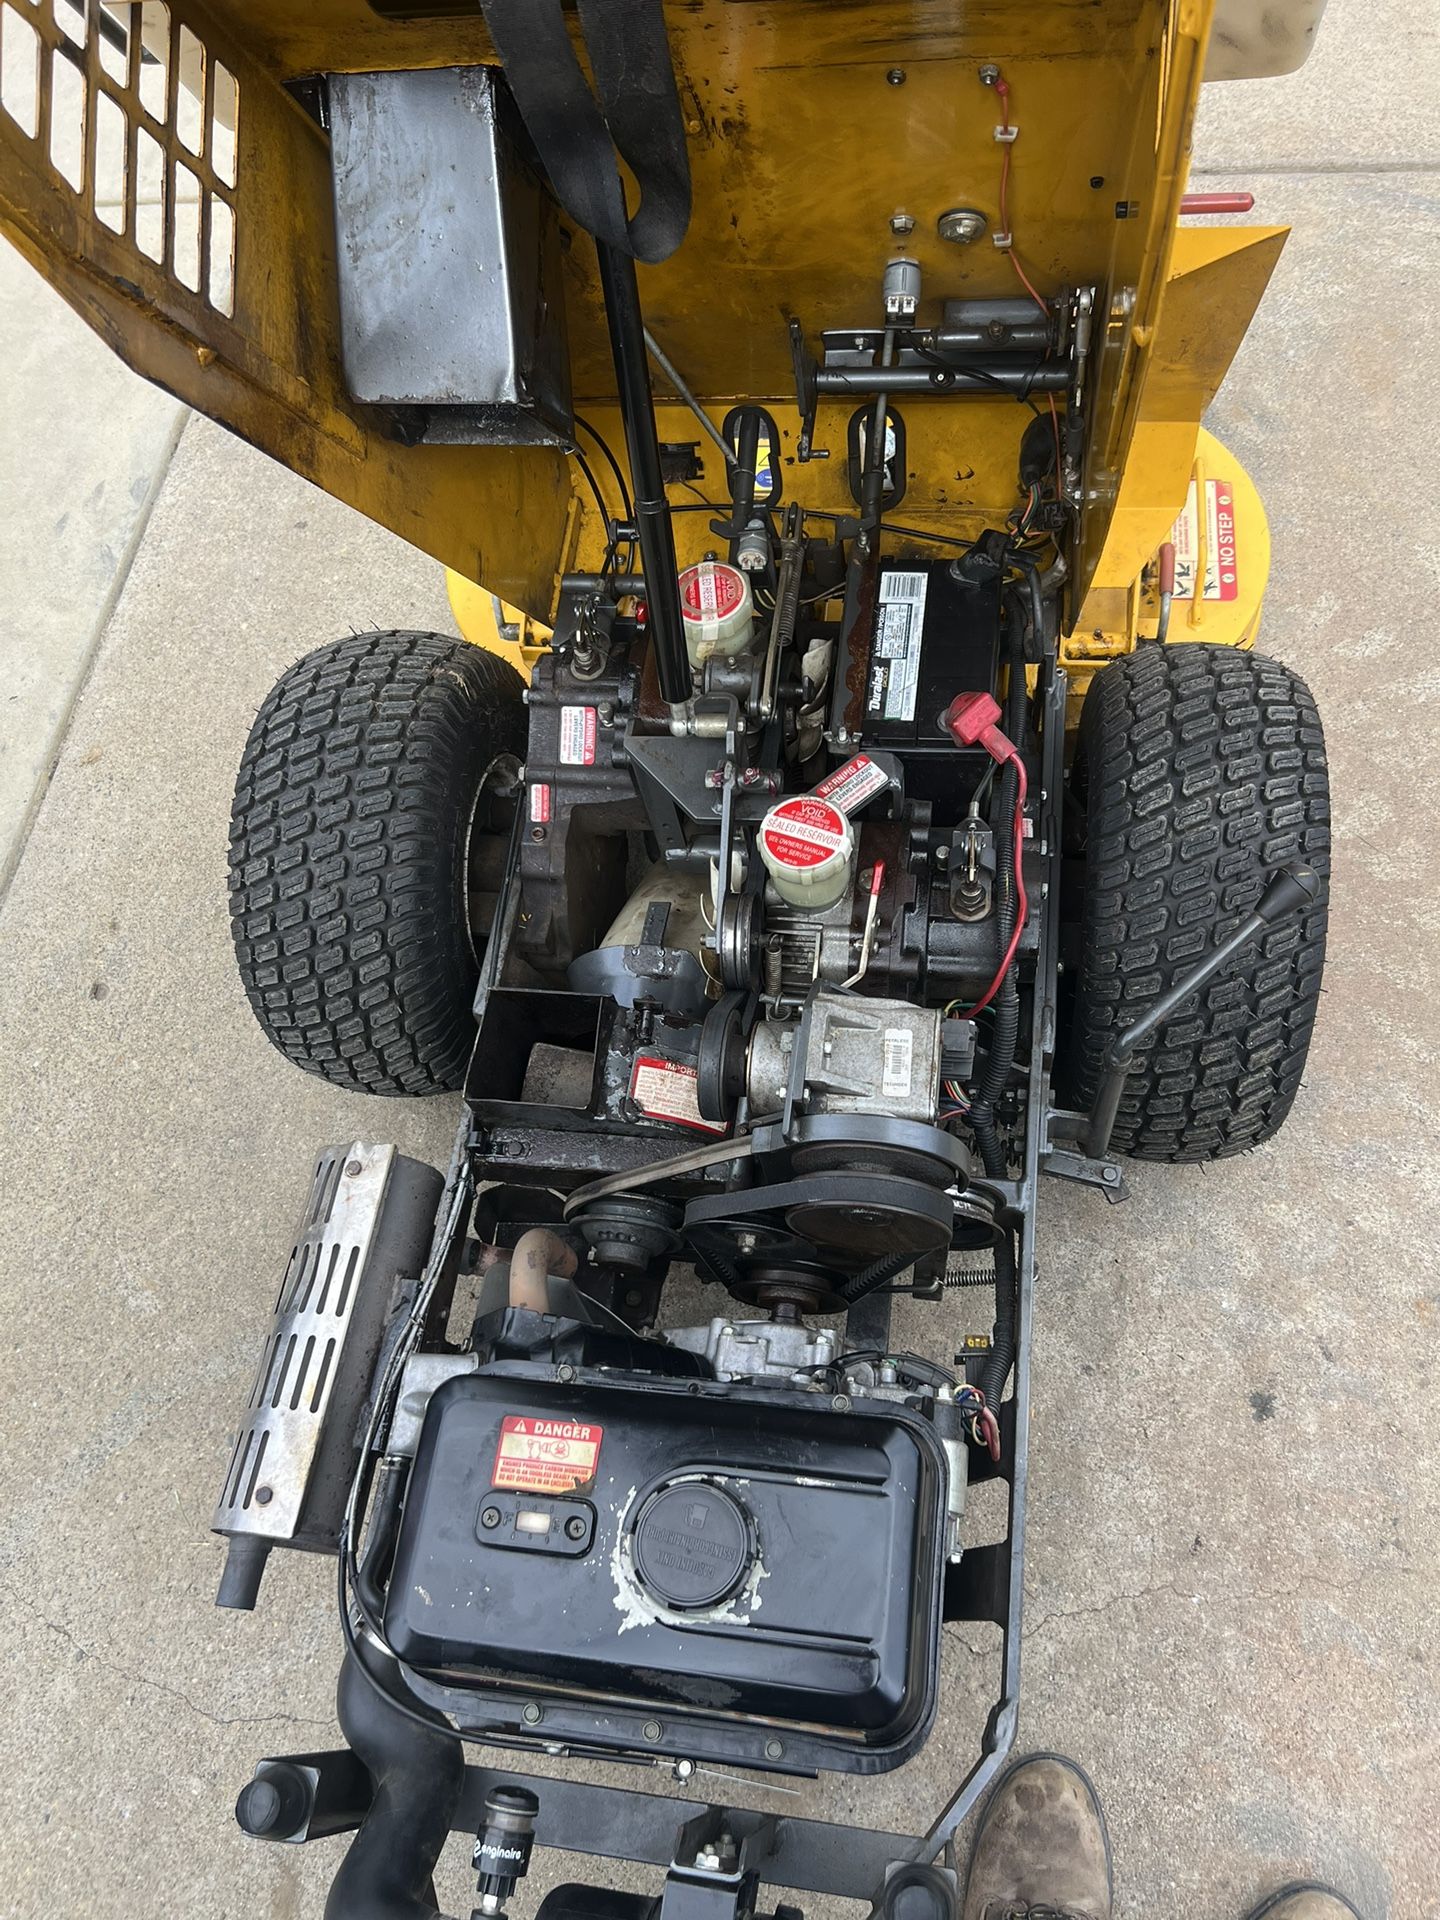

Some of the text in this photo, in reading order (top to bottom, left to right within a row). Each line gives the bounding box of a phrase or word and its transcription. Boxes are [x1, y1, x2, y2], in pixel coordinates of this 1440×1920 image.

[1218, 512, 1236, 566] NO STEP
[868, 666, 885, 711] Duralast
[585, 711, 595, 750] WARNING
[820, 765, 857, 794] WARNING
[852, 764, 873, 781] LOCKOUT
[835, 772, 873, 801] LEVERS ENGAGED
[801, 805, 826, 818] VOID
[767, 817, 842, 847] SEALED RESERVOIR
[768, 834, 827, 858] SEE OWNERS MANUAL
[776, 845, 788, 853] FOR
[788, 847, 812, 861] SERVICE
[664, 1062, 698, 1077] IMPORT
[534, 1421, 591, 1440] DANGER
[481, 1844, 522, 1860] enginaire
